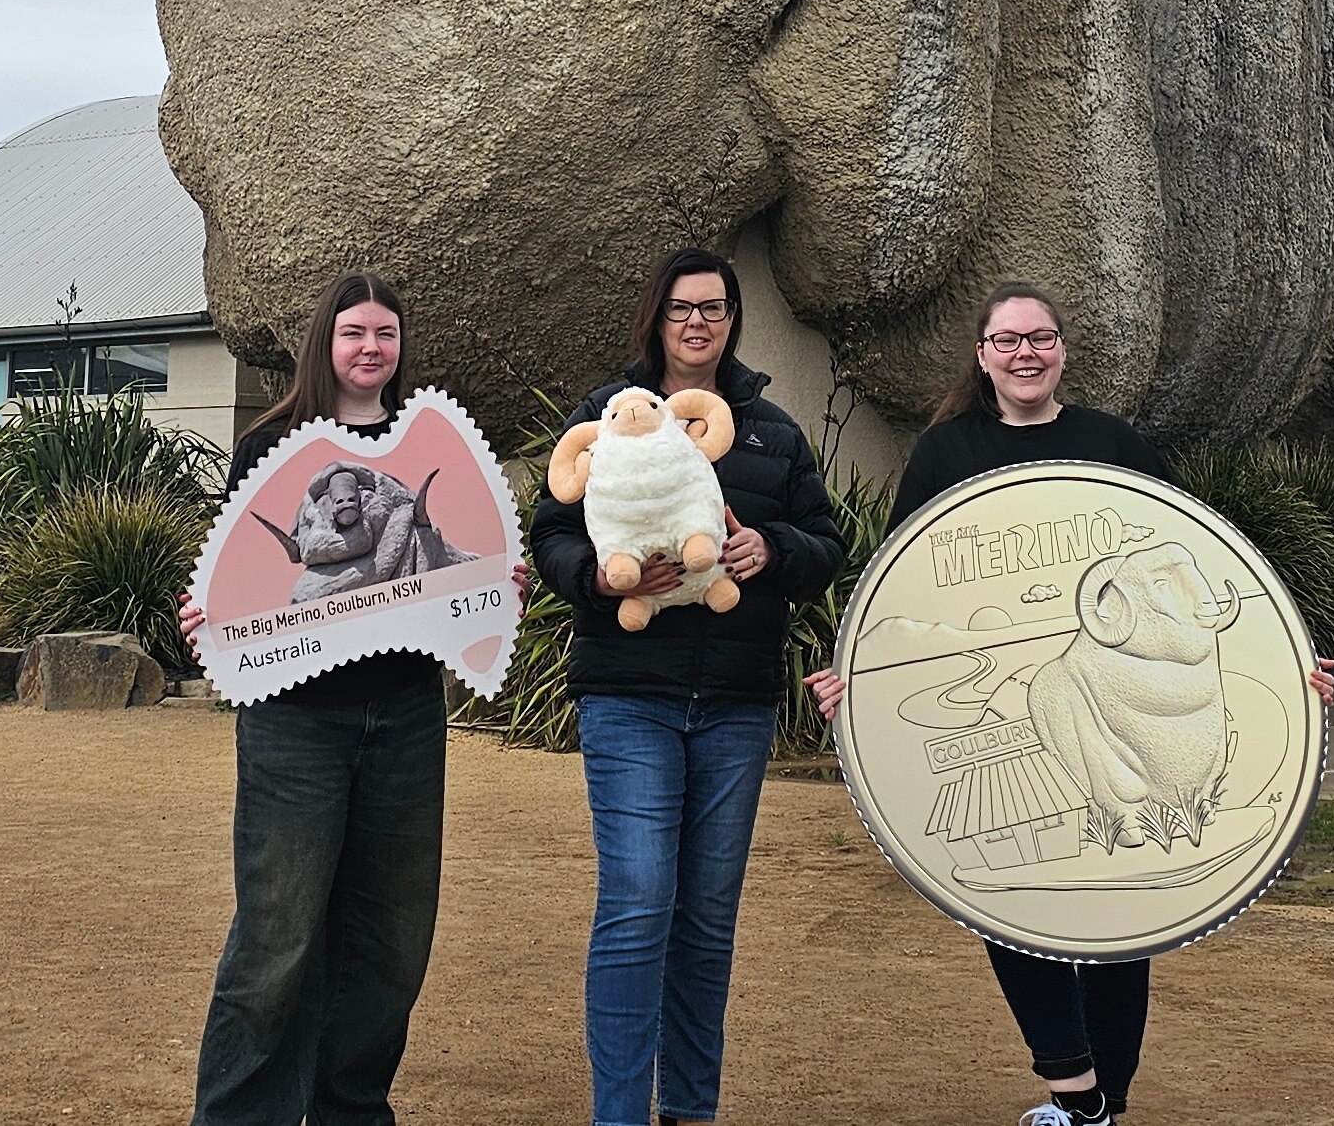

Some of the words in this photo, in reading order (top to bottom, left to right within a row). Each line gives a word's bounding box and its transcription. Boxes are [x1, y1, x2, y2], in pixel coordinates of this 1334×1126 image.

[929, 532, 953, 545] THE
[931, 507, 1124, 587] MERINO
[222, 624, 248, 643] The
[251, 618, 273, 637] Big
[276, 604, 325, 631] Merino,
[327, 590, 390, 616] Goulburn,
[391, 579, 423, 601] NSW
[450, 590, 502, 619] $1.70
[237, 637, 322, 672] Australia
